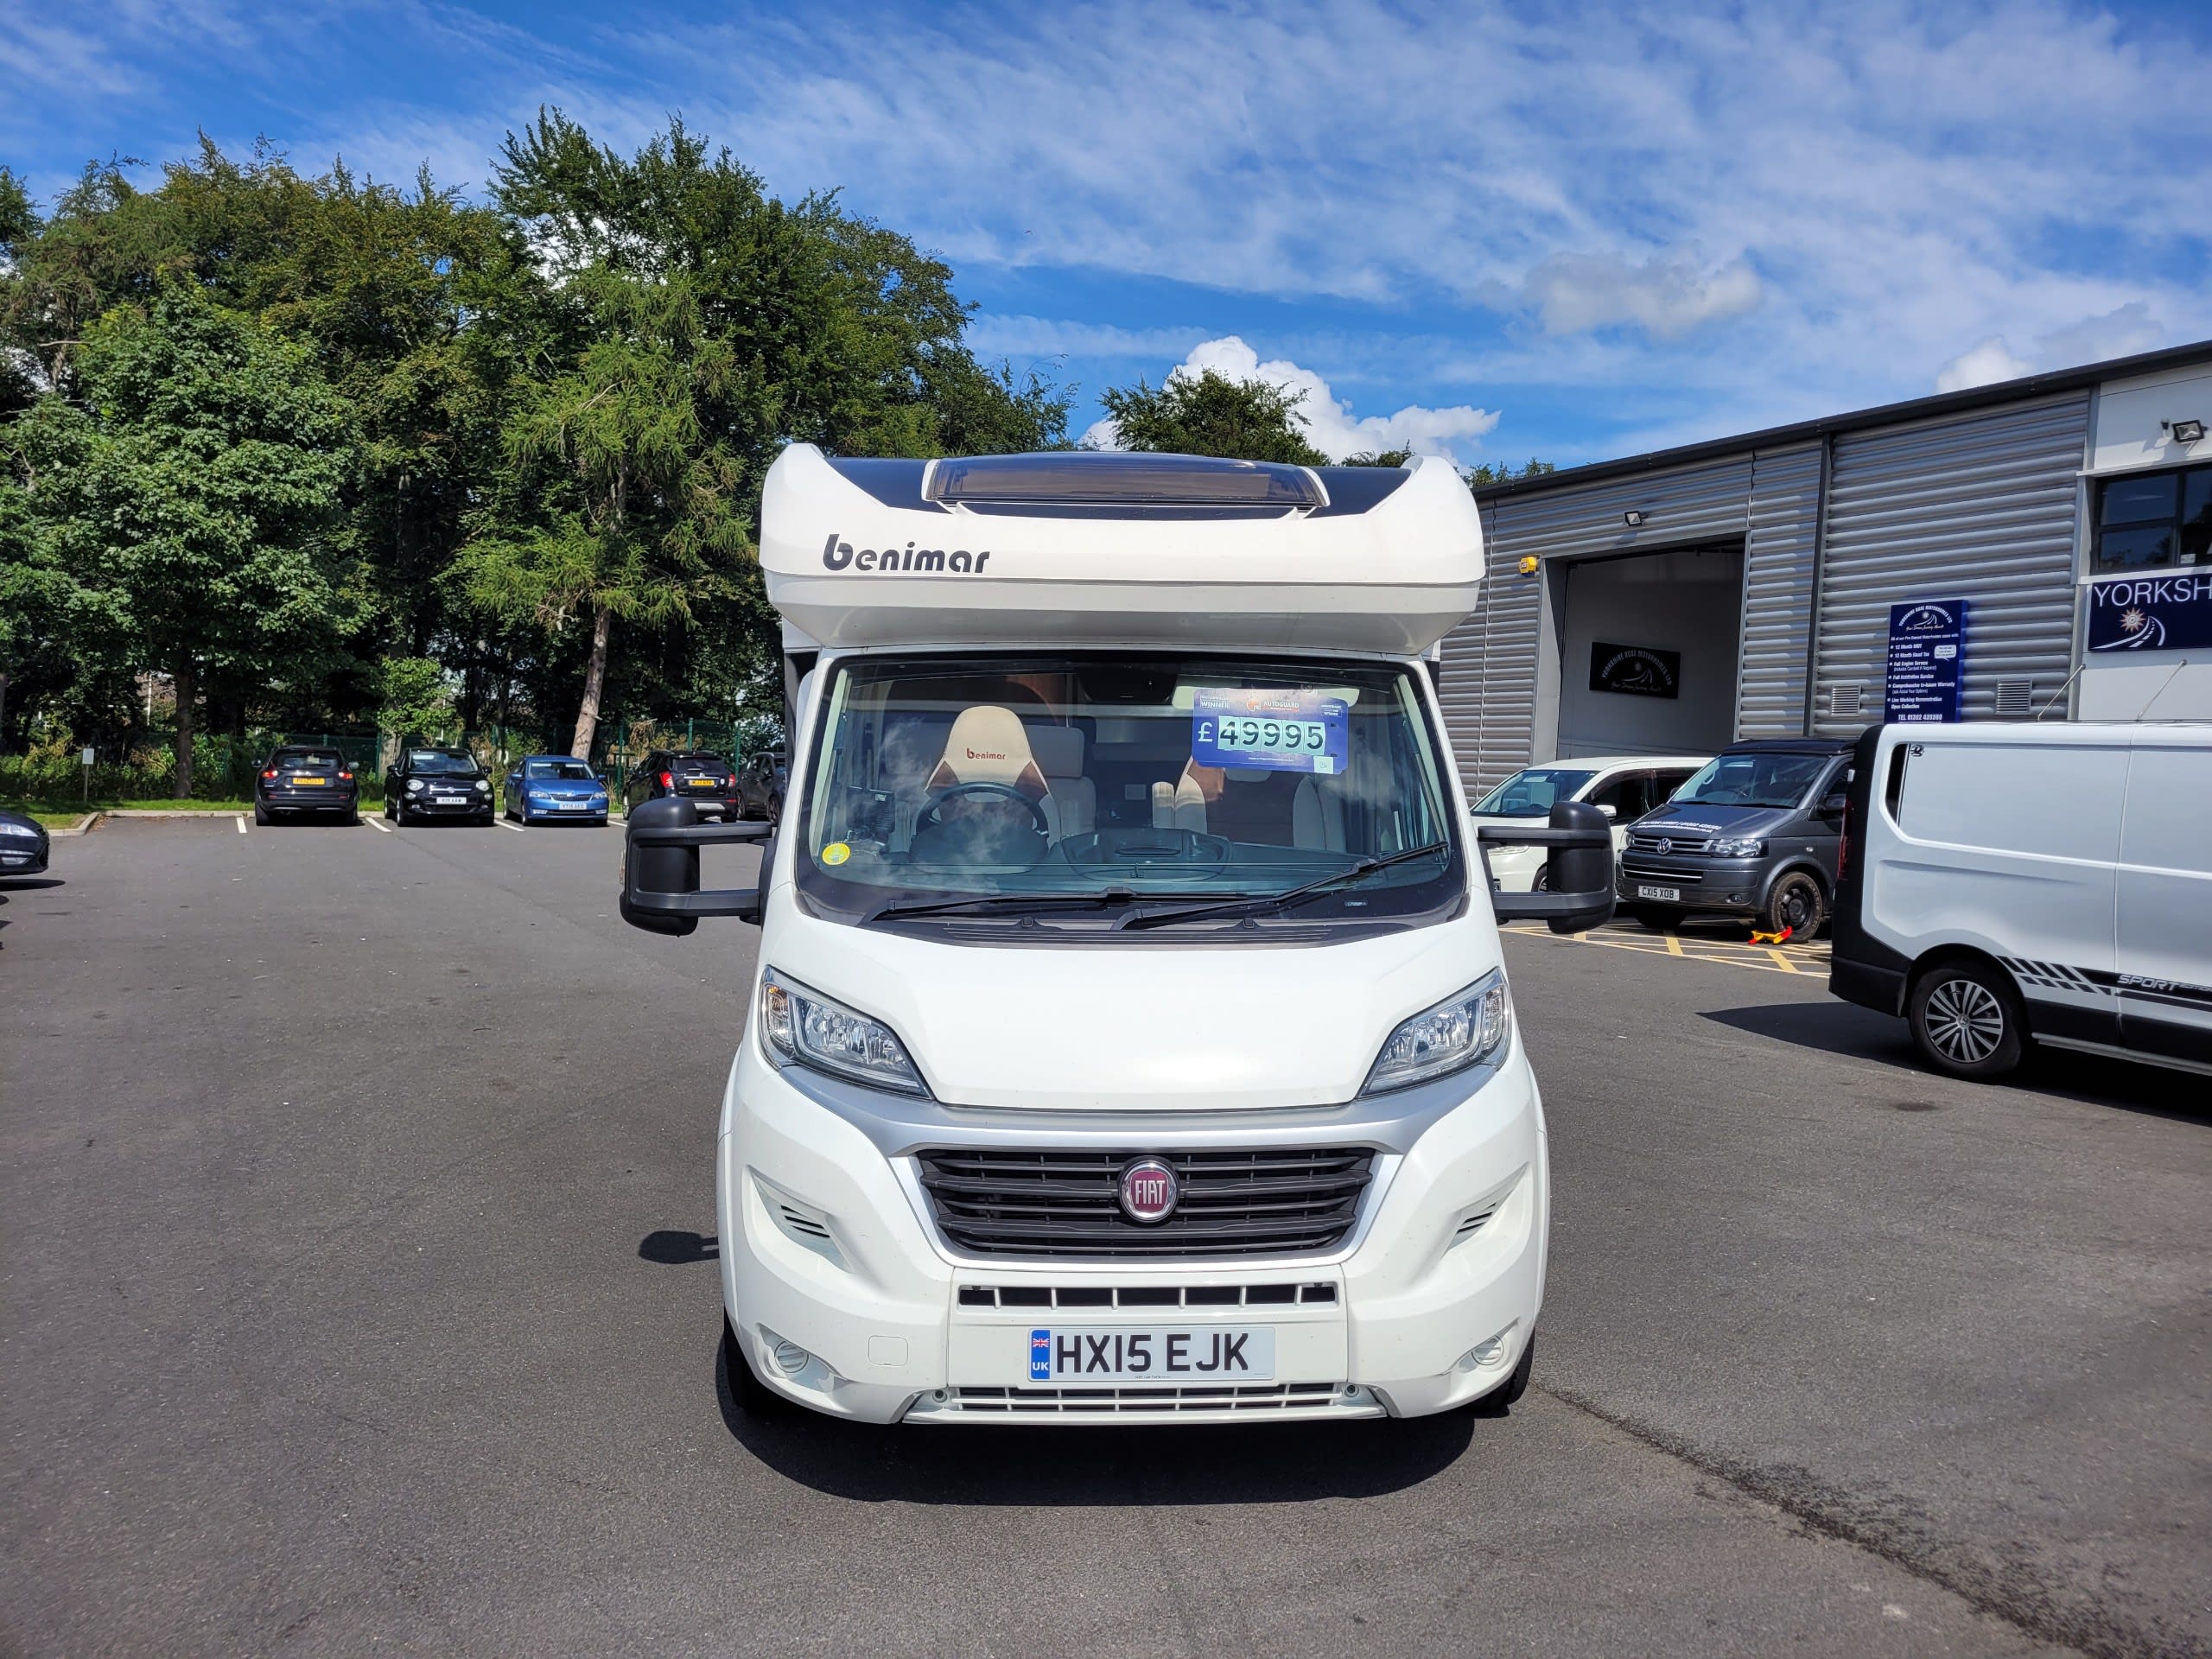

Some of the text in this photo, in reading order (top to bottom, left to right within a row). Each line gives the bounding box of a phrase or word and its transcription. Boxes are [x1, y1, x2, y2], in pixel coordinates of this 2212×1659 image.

[823, 533, 990, 574] benimar
[2094, 577, 2212, 607] YORKSH
[1198, 721, 1325, 750] £ 49995
[966, 747, 1006, 760] benimar
[1642, 887, 1674, 899] CX15 XOB
[2117, 974, 2180, 991] SPORT
[1135, 1180, 1165, 1205] FIAT
[1057, 1333, 1249, 1373] HX15 EJK
[1032, 1362, 1049, 1371] UK
